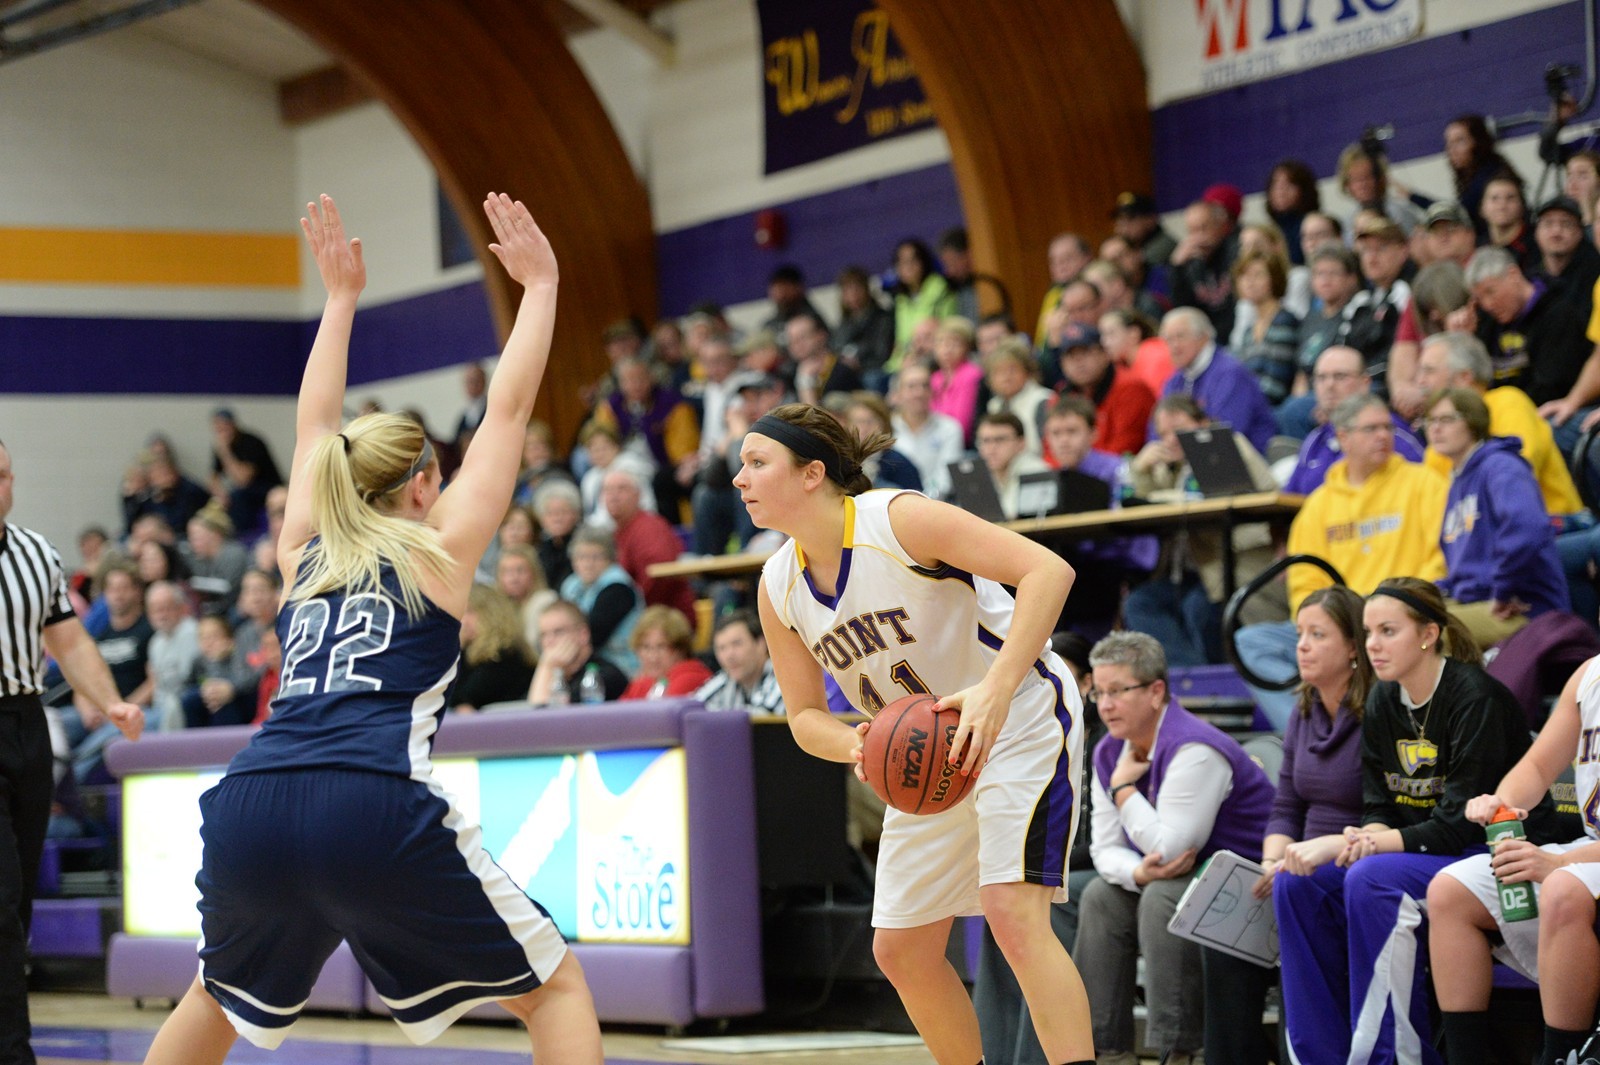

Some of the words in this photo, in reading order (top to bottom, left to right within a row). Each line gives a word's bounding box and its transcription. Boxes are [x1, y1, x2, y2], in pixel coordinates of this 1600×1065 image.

[278, 592, 395, 700] 22
[859, 659, 934, 719] 41
[902, 726, 928, 788] NCAA
[929, 725, 963, 802] Wlson
[592, 862, 675, 930] Store
[1502, 886, 1529, 910] 02
